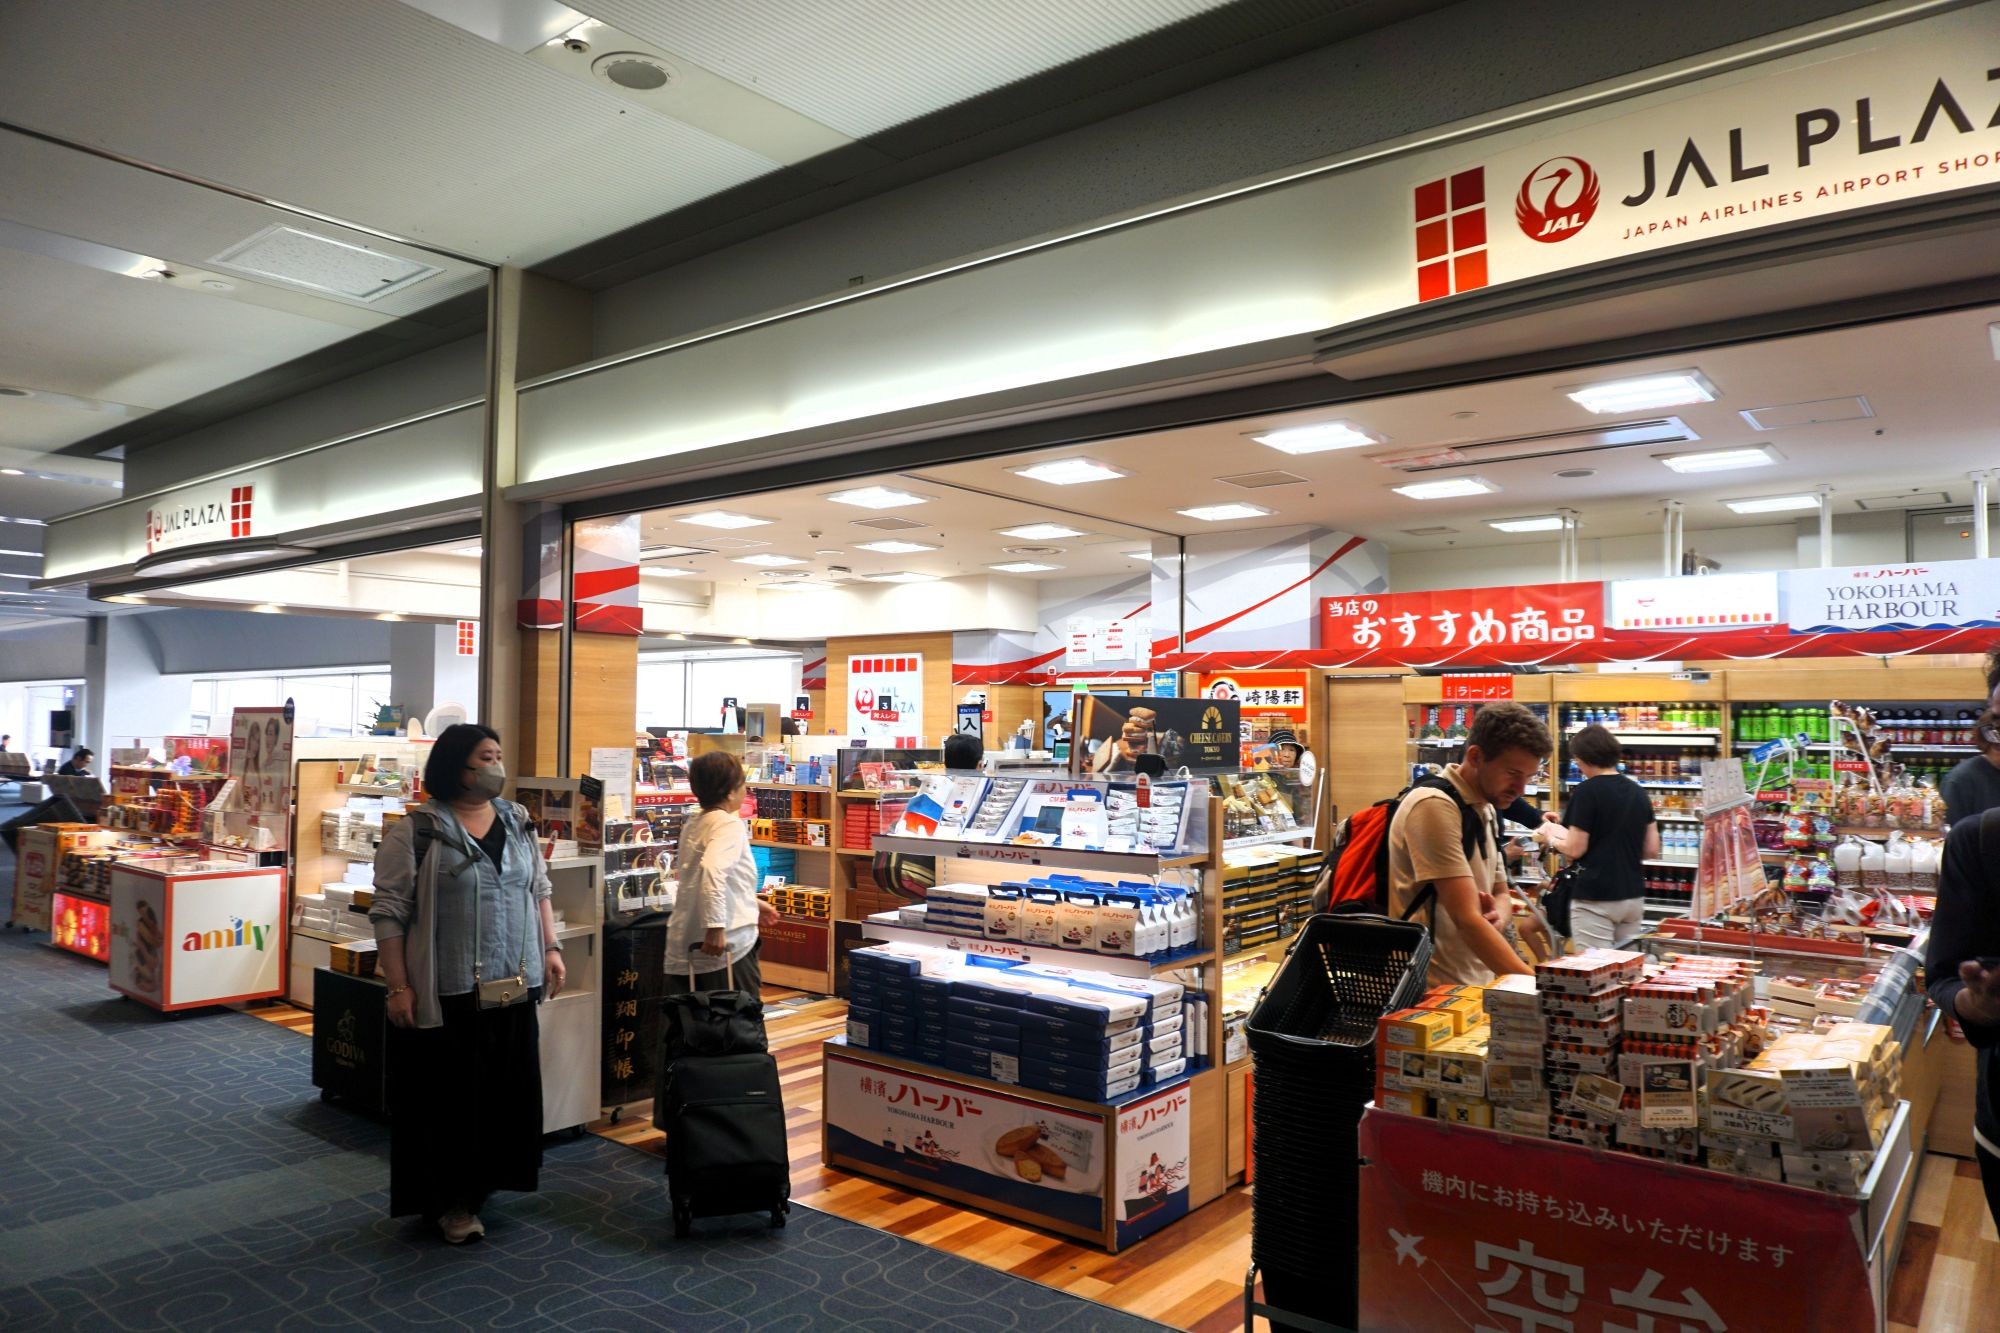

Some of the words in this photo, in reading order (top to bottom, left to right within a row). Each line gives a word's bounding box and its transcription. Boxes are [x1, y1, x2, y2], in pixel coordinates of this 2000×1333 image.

[1622, 128, 1769, 207] JAL
[1623, 216, 1688, 240] JAPAN
[1700, 191, 1803, 223] AIRLINES
[1816, 167, 1925, 199] AIRPORT
[1537, 213, 1585, 236] JAL
[164, 511, 181, 533] JAL
[184, 503, 226, 528] PLAZA
[1825, 582, 1959, 601] YOKOHAMA
[1328, 599, 1378, 618] 当店の
[1826, 600, 1959, 621] HARBOUR
[1352, 606, 1596, 649] おすすめ商品
[1246, 689, 1300, 706] 崎陽軒
[1458, 686, 1511, 697] ラーメン
[727, 699, 735, 707] 5
[881, 702, 888, 710] 3
[962, 717, 978, 731] 入
[920, 1114, 955, 1129] HARBOUR
[1421, 1168, 1795, 1269] 機内にお持ち込みいただけます
